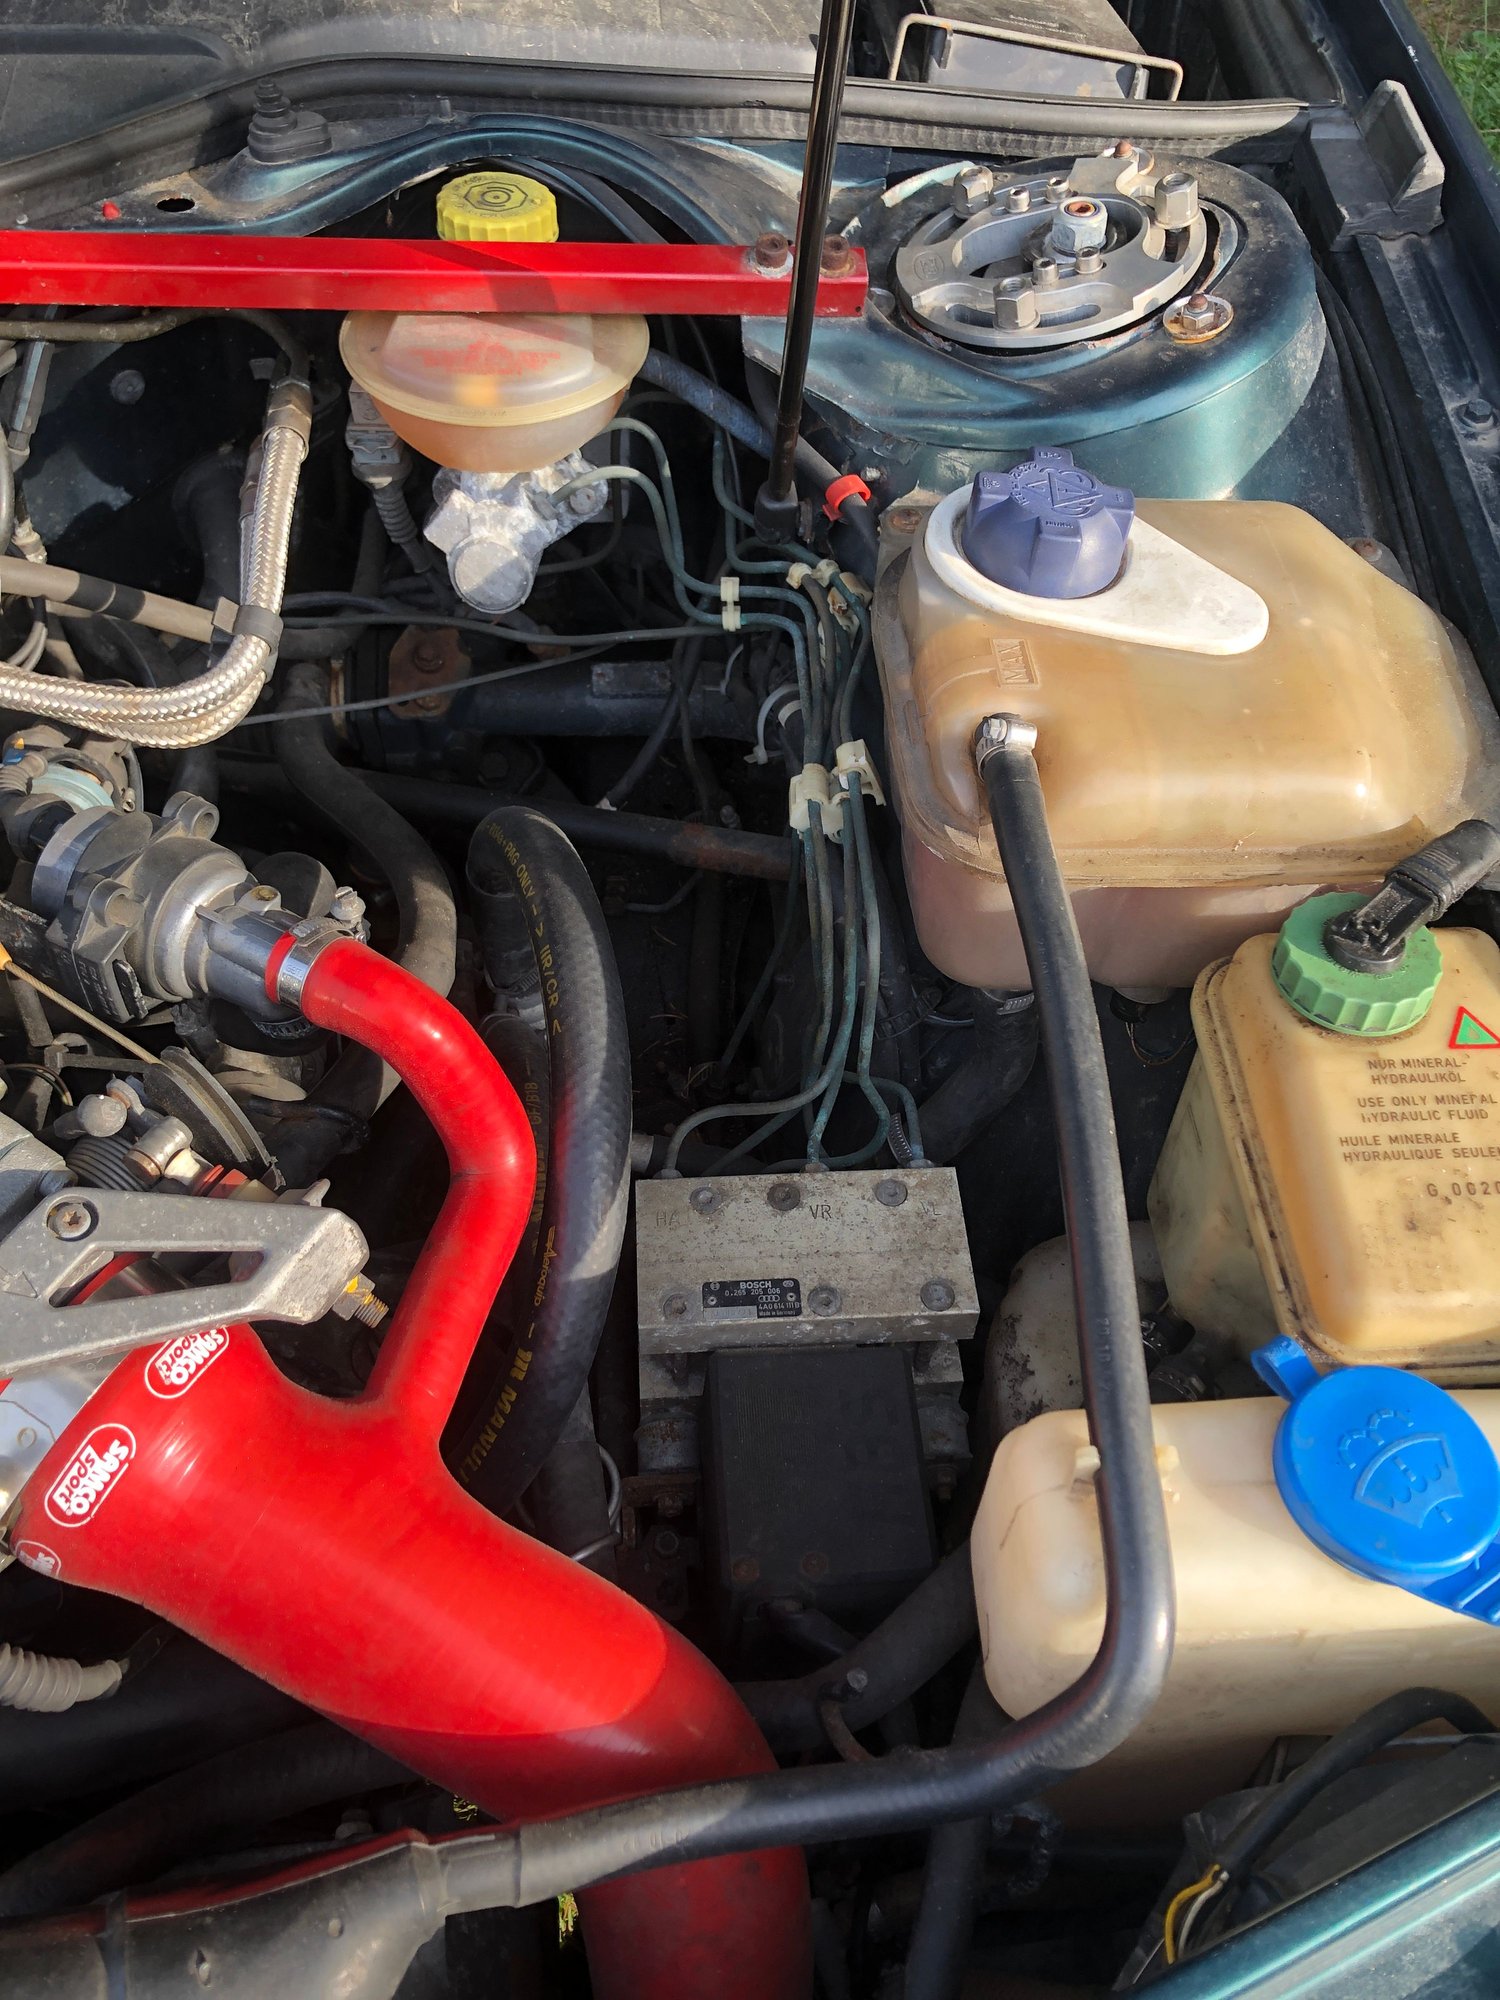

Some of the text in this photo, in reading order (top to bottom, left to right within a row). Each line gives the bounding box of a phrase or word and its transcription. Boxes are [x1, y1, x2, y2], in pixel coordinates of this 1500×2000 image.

[504, 841, 521, 867] PAG
[516, 863, 536, 900] ONLY
[1367, 1056, 1468, 1071] NUR MINERAL-
[1371, 1071, 1466, 1085] HYDRAULIKÖL
[1357, 1097, 1385, 1108] USE
[1392, 1095, 1427, 1108] ONLY
[1448, 1108, 1490, 1122] FLUID
[1338, 1132, 1462, 1148] HUILE MINERALE
[1342, 1148, 1444, 1164] HYDRAULIQUE
[809, 1203, 833, 1221] VR
[534, 1247, 557, 1308] Aeroquip
[740, 1281, 772, 1289] BOSCH
[159, 1332, 202, 1376] sport
[168, 1328, 226, 1386] SAMCO
[459, 1382, 518, 1485] MANULI
[58, 1450, 97, 1508] sport
[69, 1438, 130, 1517] SAMCO
